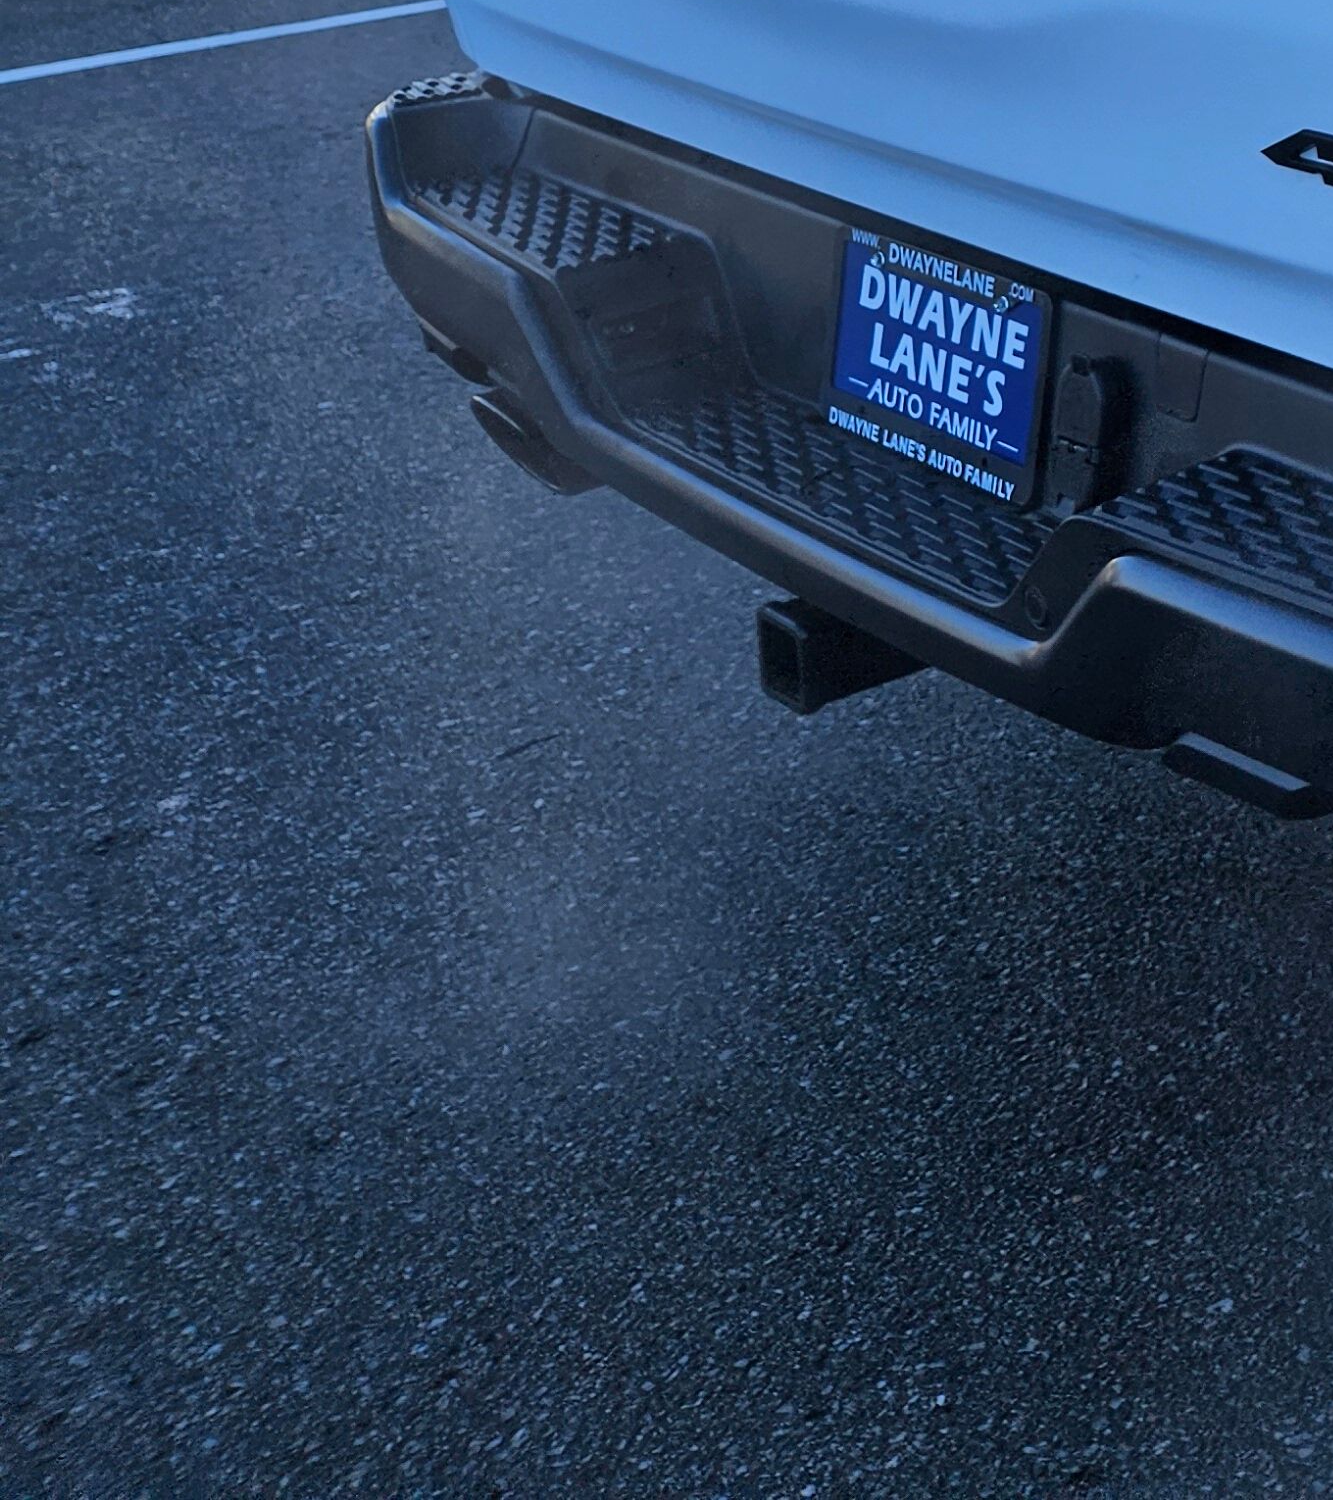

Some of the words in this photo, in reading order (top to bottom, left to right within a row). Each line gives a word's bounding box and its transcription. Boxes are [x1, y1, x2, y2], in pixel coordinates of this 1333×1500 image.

[859, 264, 1029, 370] DWAYNE
[888, 242, 996, 298] DWAYNELANE
[866, 378, 924, 419] AUTO
[928, 401, 998, 451] FAMILY
[869, 322, 1006, 416] LANE'S
[828, 405, 880, 443] DWAYNE
[882, 429, 927, 463] LANE'S
[928, 449, 963, 478] AUTO
[964, 463, 1016, 501] FAMILY
